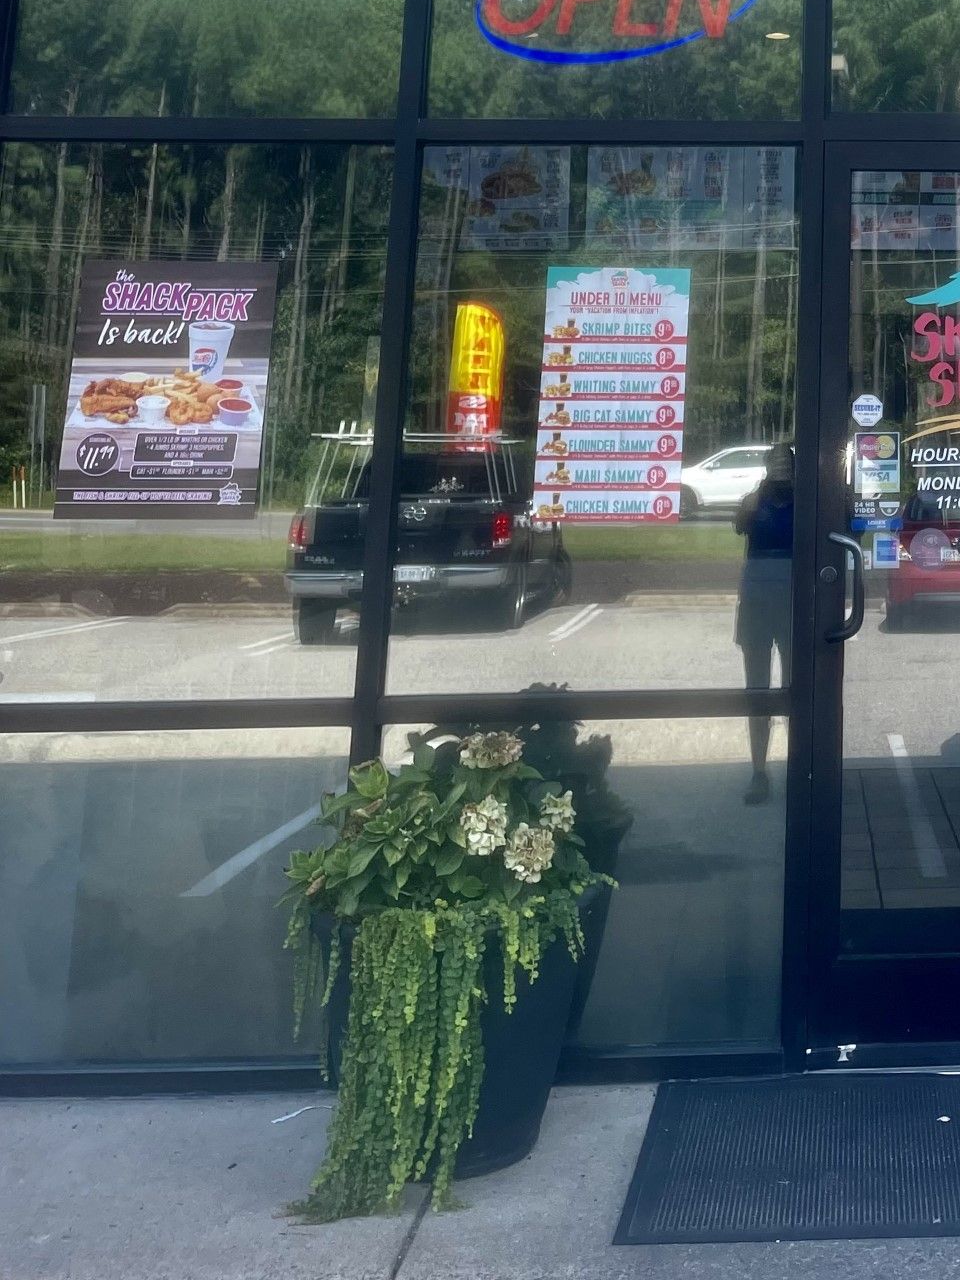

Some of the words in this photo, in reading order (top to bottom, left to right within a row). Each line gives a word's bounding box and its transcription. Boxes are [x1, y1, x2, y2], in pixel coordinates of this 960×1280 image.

[116, 269, 136, 282] the
[102, 282, 191, 311] SHACK
[183, 293, 254, 321] PACK
[571, 292, 610, 306] UNDER
[614, 292, 626, 306] 10
[630, 292, 662, 306] MENU
[98, 319, 121, 345] Is
[124, 319, 186, 345] back!
[582, 322, 620, 336] SKRIMP
[624, 322, 652, 336] BITES
[578, 351, 618, 364] CHICKEN
[620, 351, 652, 364] NUGGS
[574, 380, 616, 393] WHITING
[573, 410, 591, 423] BIG
[595, 410, 612, 423] CAT
[569, 440, 616, 452] FLOUNDER
[575, 470, 600, 483] MAHI
[566, 500, 609, 513] CHICKEN
